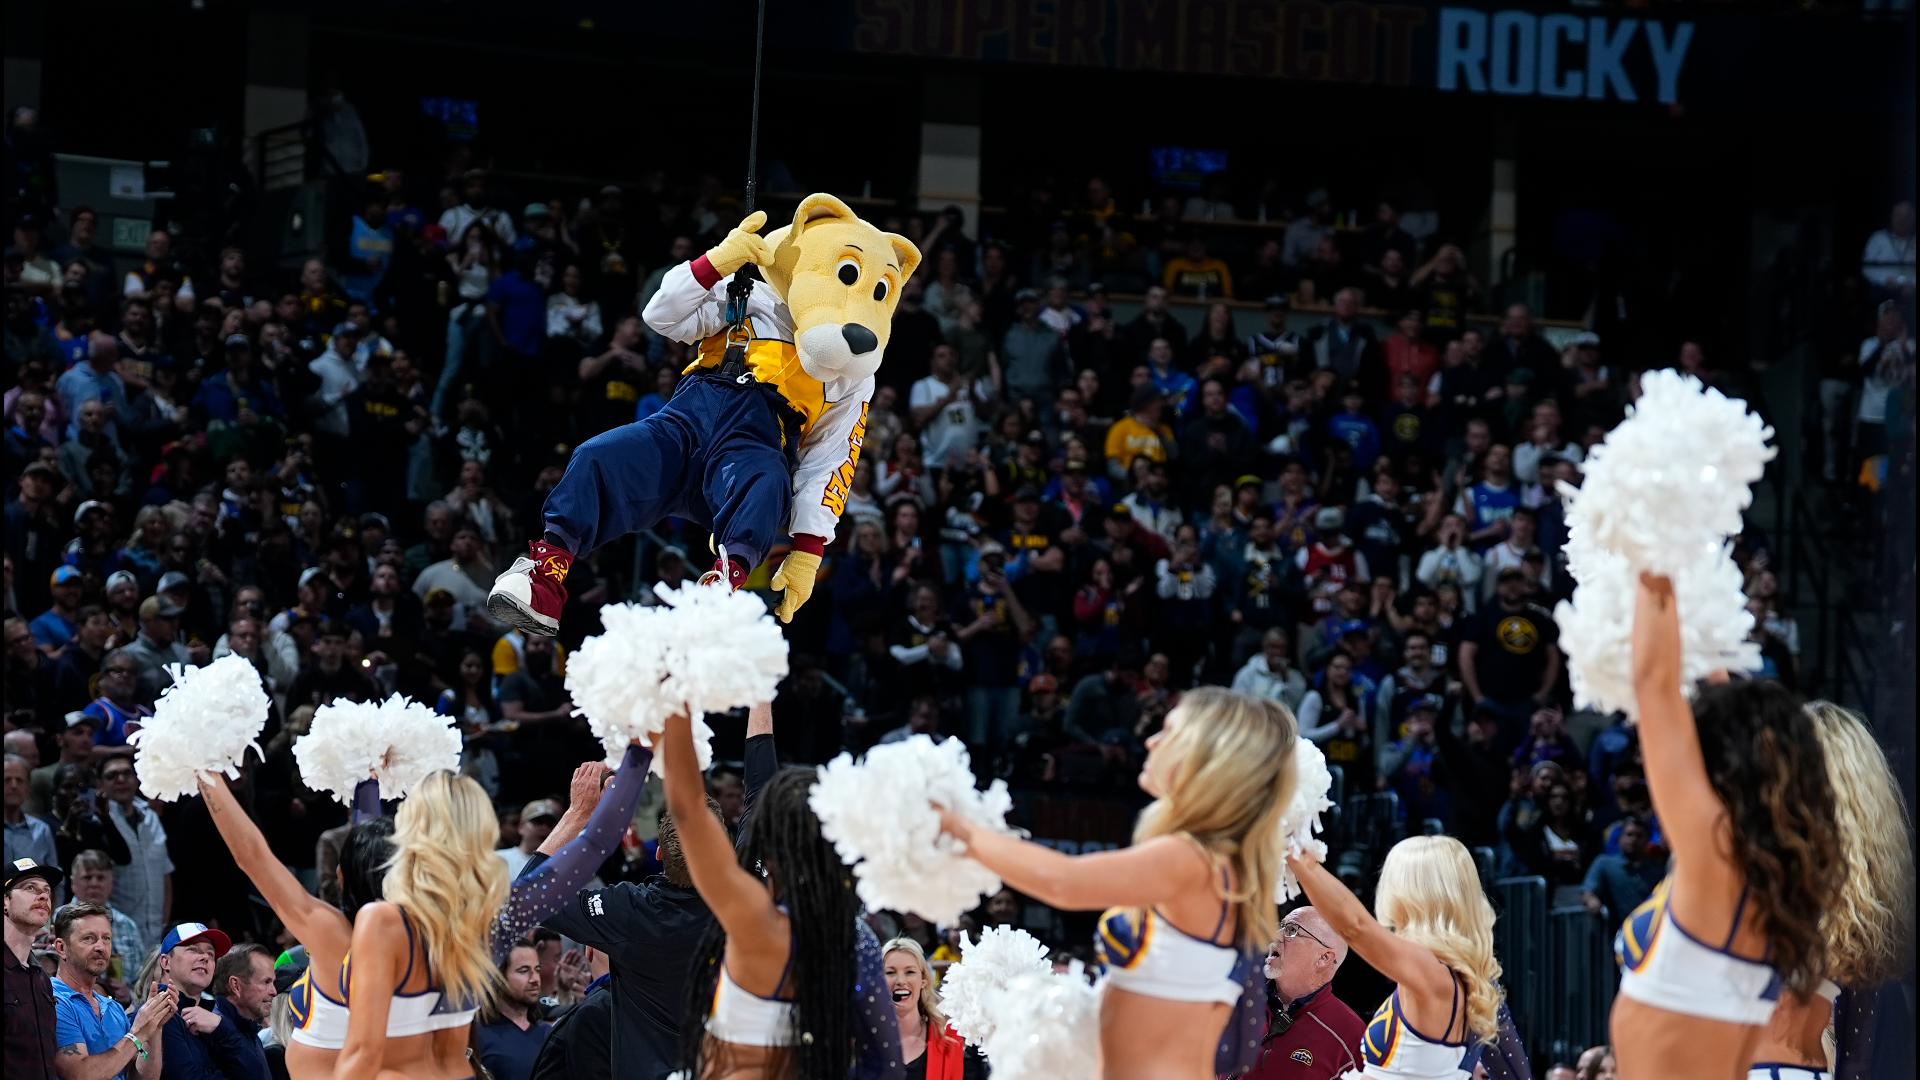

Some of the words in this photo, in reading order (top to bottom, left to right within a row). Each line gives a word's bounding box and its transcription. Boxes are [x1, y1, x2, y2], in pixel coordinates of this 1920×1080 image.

[853, 0, 1106, 69] SUPER
[1116, 0, 1422, 86] MASCOT
[1436, 6, 1695, 106] ROCKY
